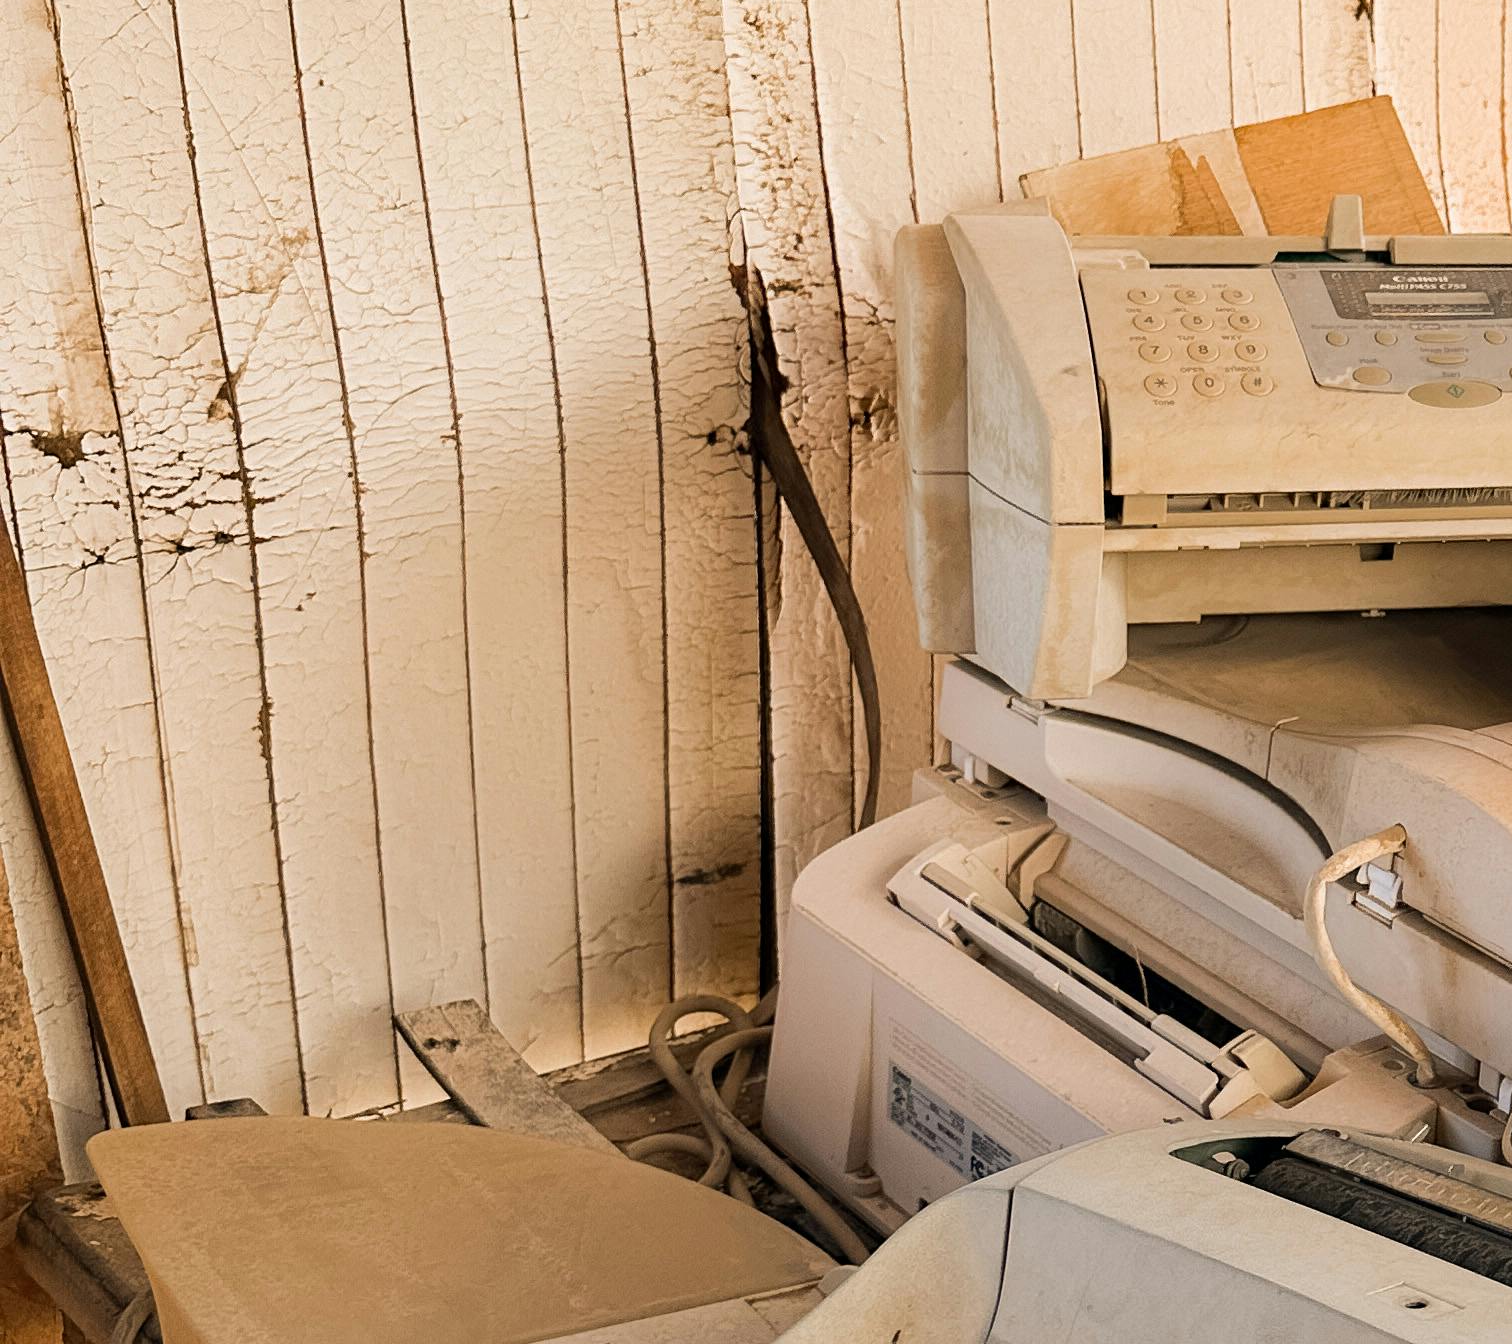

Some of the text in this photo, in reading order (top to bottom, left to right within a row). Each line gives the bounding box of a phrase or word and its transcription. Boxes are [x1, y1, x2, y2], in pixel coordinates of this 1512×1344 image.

[1392, 275, 1448, 283] Canon
[1185, 290, 1196, 298] 2
[1144, 316, 1154, 324] 4
[1193, 316, 1203, 325] 5
[1239, 316, 1250, 324] 6
[1150, 345, 1160, 355] 7
[1198, 345, 1208, 355] 8
